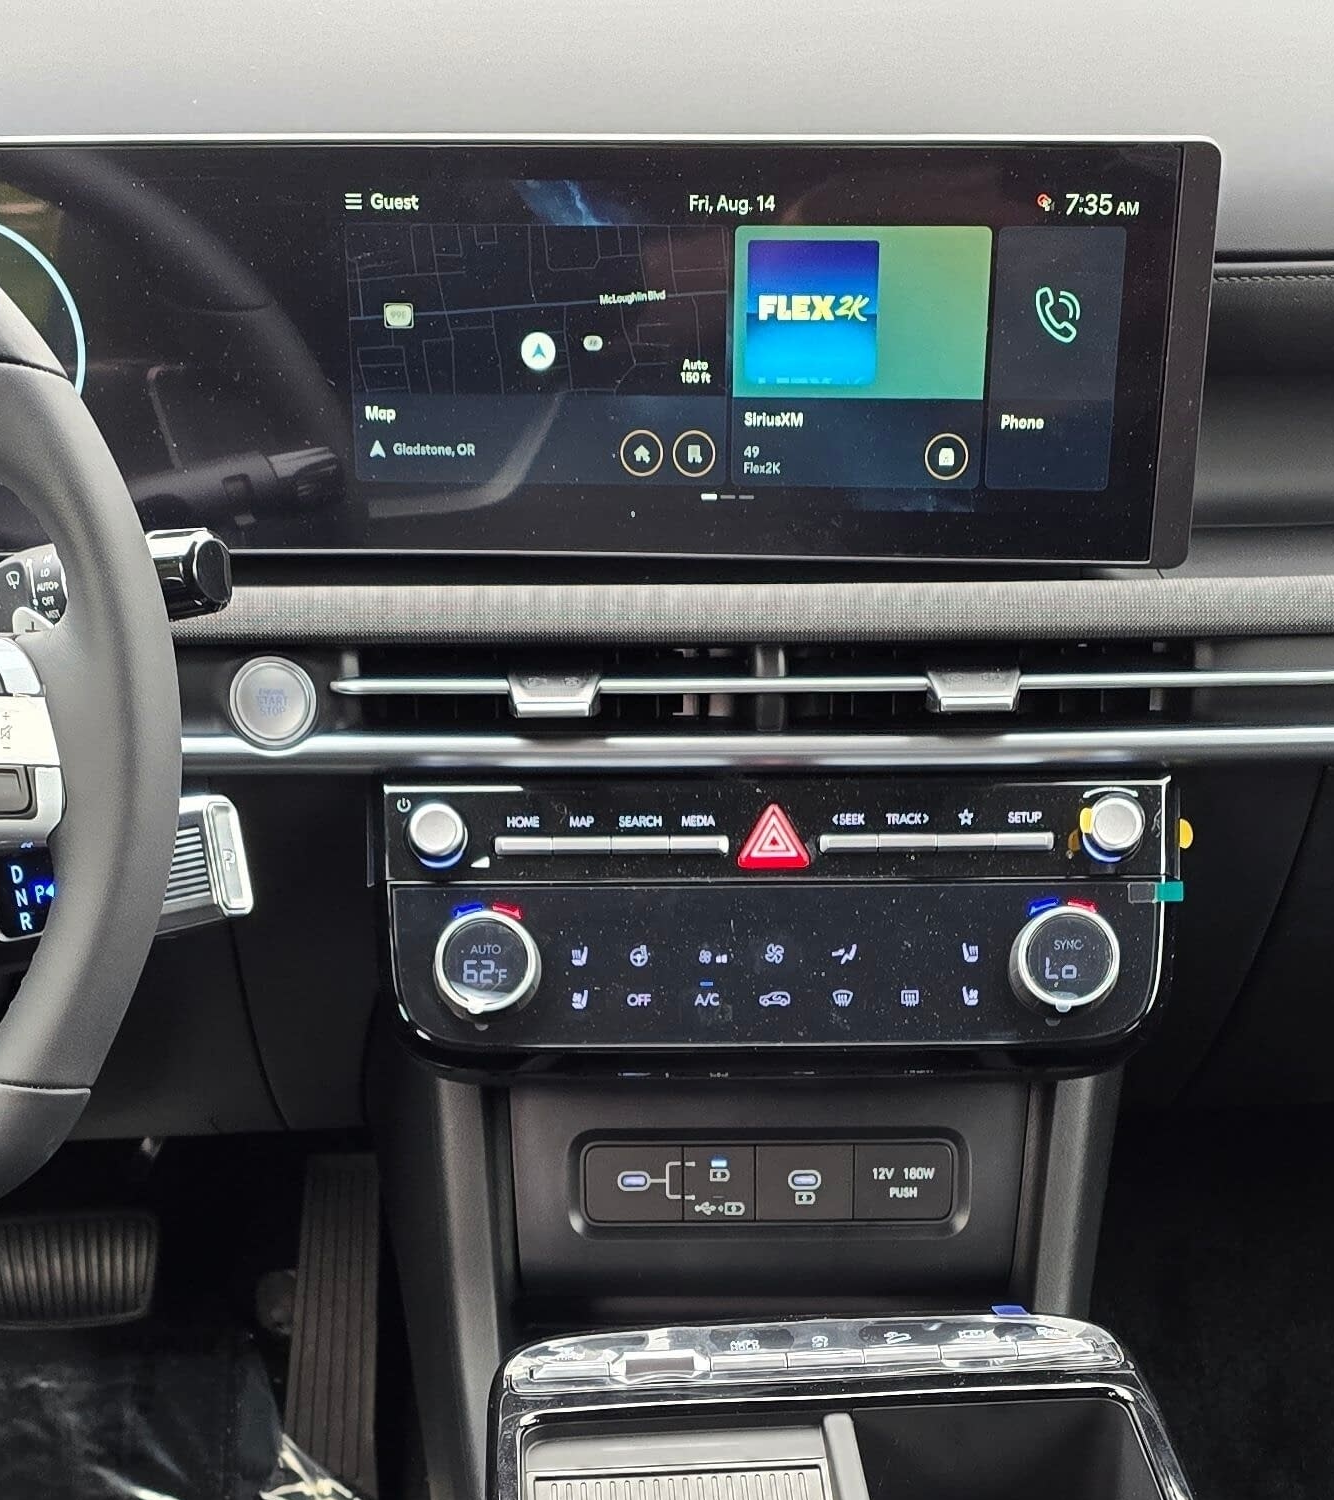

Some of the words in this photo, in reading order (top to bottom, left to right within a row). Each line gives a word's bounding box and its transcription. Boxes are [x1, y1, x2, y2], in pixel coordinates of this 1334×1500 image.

[370, 193, 419, 211] Guest
[689, 194, 713, 214] Fri,
[756, 195, 775, 212] 14
[1065, 193, 1113, 216] 7:35
[1116, 201, 1140, 216] AM
[599, 290, 648, 306] McLoughlin
[647, 289, 666, 301] Blvd
[758, 295, 835, 321] FLEX
[682, 359, 708, 371] Auto
[680, 372, 699, 384] 150
[701, 371, 712, 384] ft
[364, 405, 396, 424] Map
[743, 411, 803, 428] SiriusXM
[1000, 414, 1044, 430] Phone
[392, 442, 455, 457] Gladstone,
[457, 444, 476, 456] OR
[743, 446, 760, 458] 49
[743, 462, 781, 475] Flex2K
[40, 568, 51, 578] LO
[506, 816, 540, 828] HOME
[569, 816, 595, 828] MAP
[618, 815, 663, 828] SEARCH
[681, 815, 716, 827] MEDIA
[839, 813, 866, 826] SEEK
[886, 813, 922, 825] TRACK
[1007, 811, 1043, 824] SETUP
[10, 865, 23, 884] D
[15, 888, 29, 907] N
[34, 885, 45, 904] P
[19, 912, 33, 931] R
[470, 944, 502, 955] AUTO
[1053, 939, 1084, 951] SYNC
[627, 993, 652, 1007] OFF
[694, 993, 720, 1007] A/C
[872, 1167, 895, 1180] 12V
[903, 1167, 936, 1180] 180W
[889, 1186, 918, 1199] PUSH
